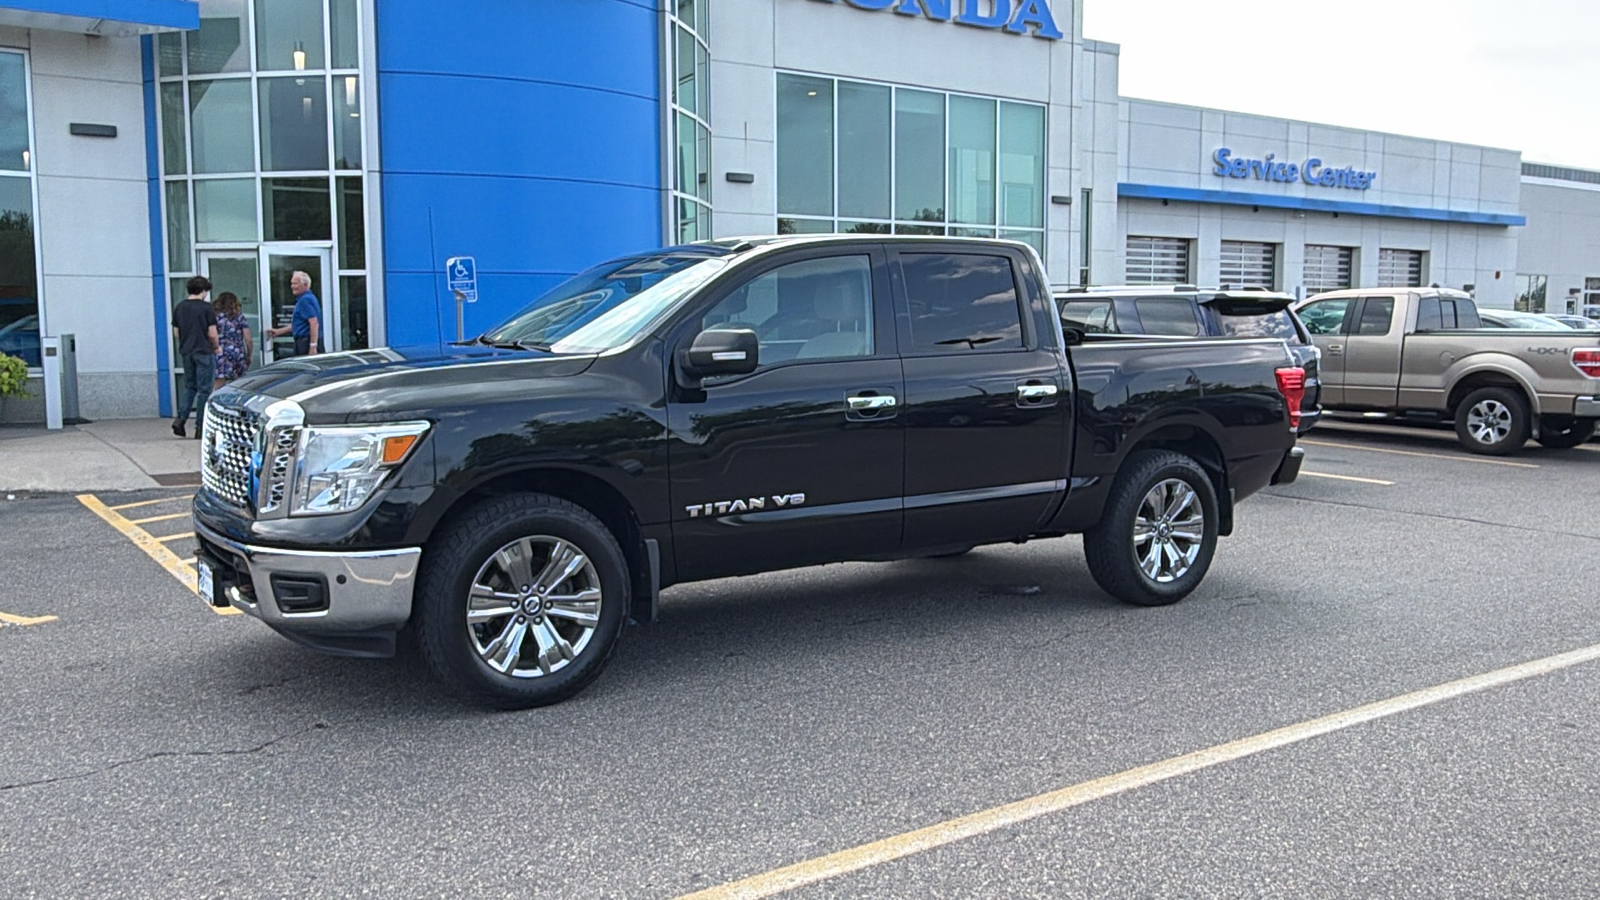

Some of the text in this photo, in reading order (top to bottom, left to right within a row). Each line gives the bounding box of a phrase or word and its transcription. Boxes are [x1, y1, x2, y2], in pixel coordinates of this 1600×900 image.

[1212, 147, 1377, 190] Service Center
[685, 492, 806, 518] TITAN V8
